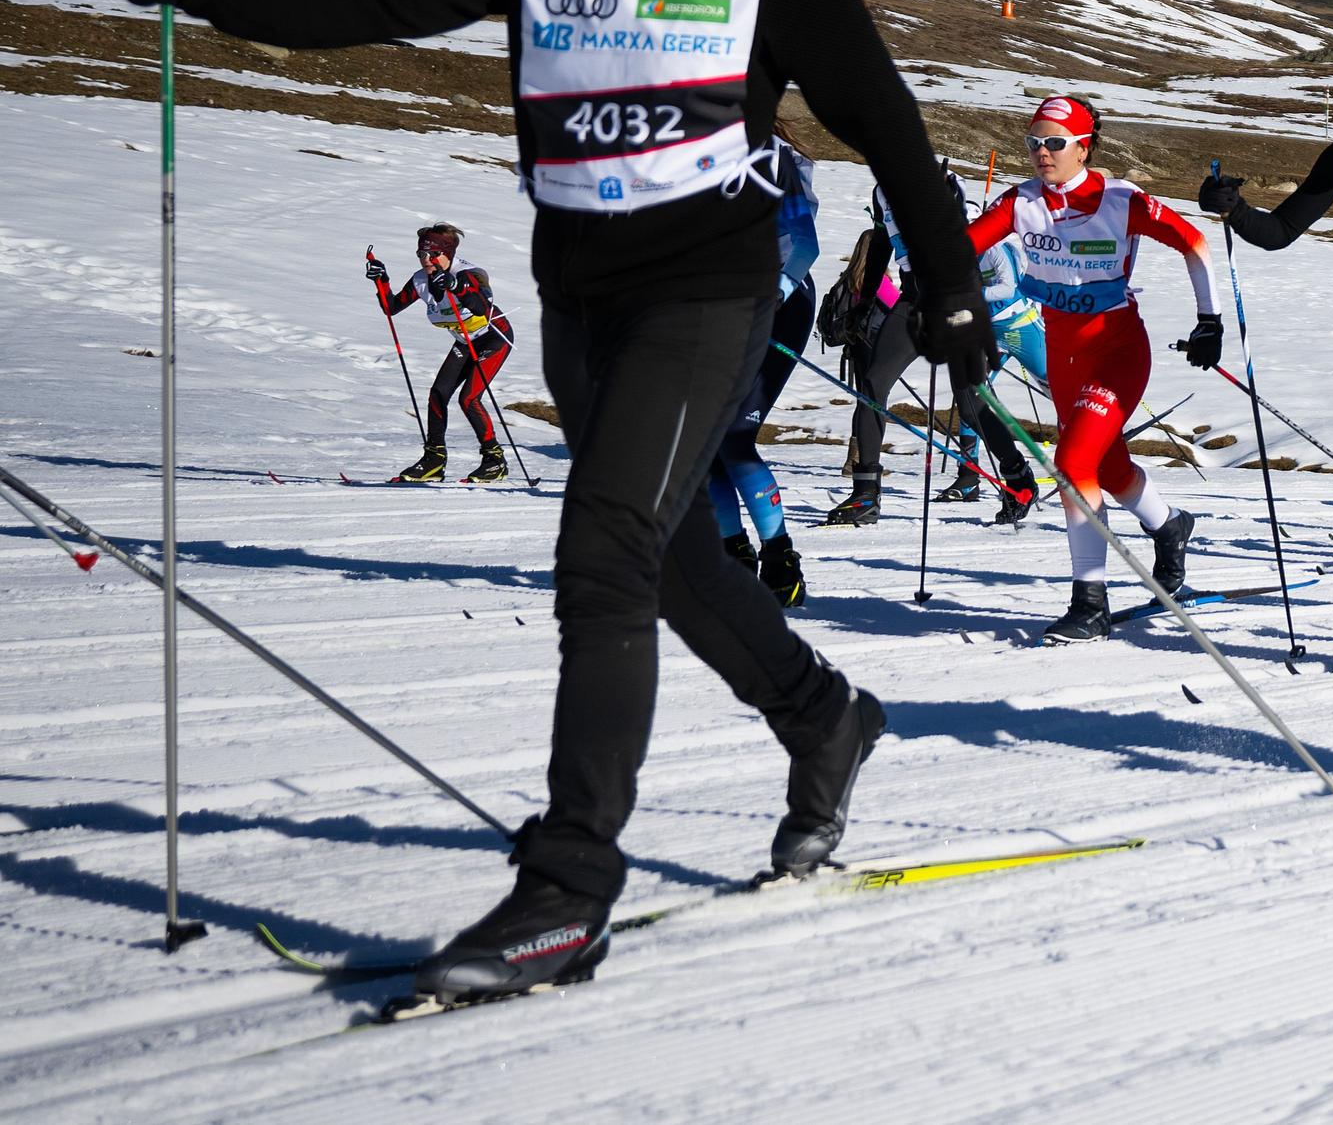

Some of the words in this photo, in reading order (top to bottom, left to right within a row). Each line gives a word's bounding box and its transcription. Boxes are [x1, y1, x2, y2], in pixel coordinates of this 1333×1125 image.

[665, 3, 727, 17] IBERDROLA
[580, 30, 655, 52] MARXA
[661, 33, 737, 57] BERET
[564, 101, 686, 145] 4032
[1084, 258, 1120, 272] BERET
[503, 925, 588, 962] SALOMON
